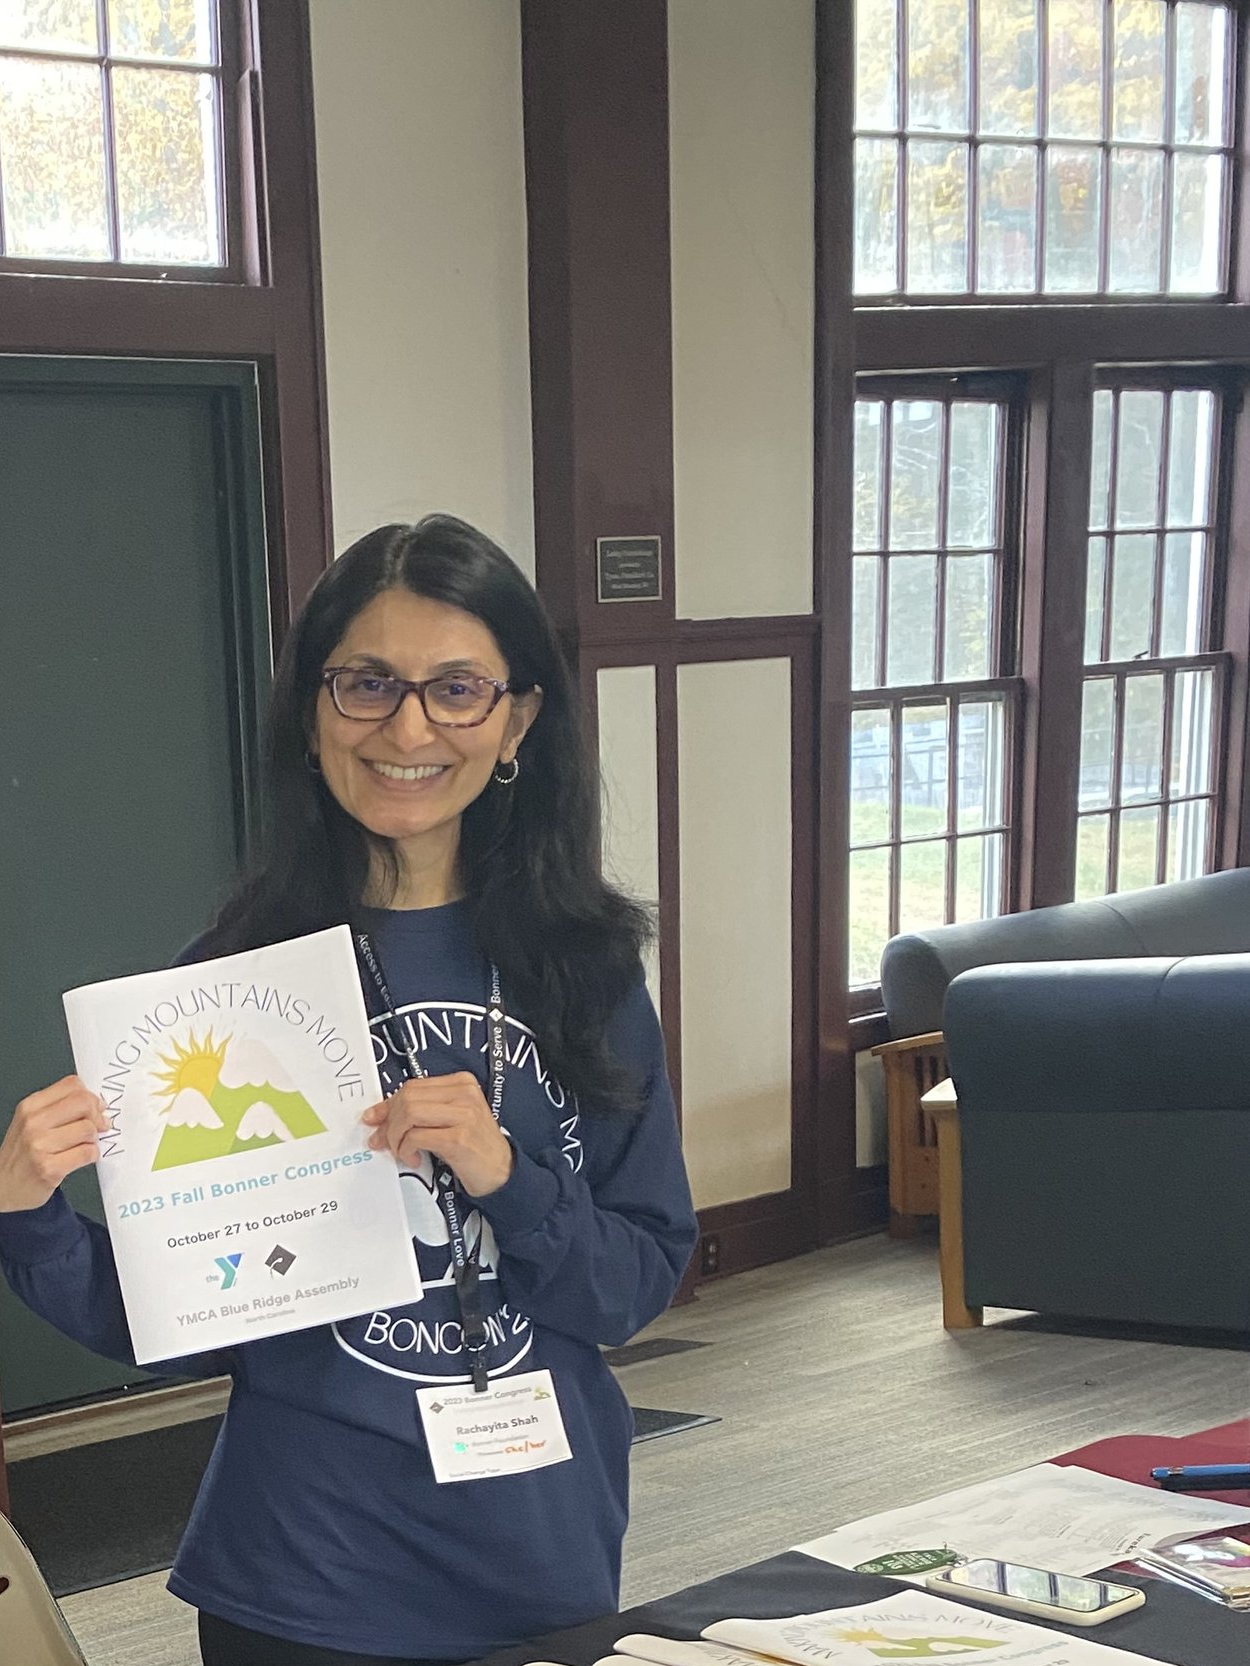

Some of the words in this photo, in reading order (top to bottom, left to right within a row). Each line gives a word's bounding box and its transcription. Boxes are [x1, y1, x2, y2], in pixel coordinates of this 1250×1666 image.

[493, 1027, 503, 1057] Serve
[99, 1039, 141, 1158] MAKING
[132, 983, 311, 1044] MOUNTAINS
[306, 1014, 365, 1102] MOVE
[492, 1065, 506, 1120] ortunity
[119, 1197, 165, 1219] 2023
[171, 1187, 205, 1207] Fall
[210, 1170, 279, 1197] Bonner
[285, 1149, 373, 1182] Congress
[167, 1229, 221, 1249] October
[225, 1223, 242, 1236] 27
[245, 1220, 259, 1231] to
[263, 1206, 317, 1228] October
[320, 1201, 338, 1214] 29
[445, 1192, 459, 1234] Bonner
[454, 1238, 465, 1267] Love
[176, 1309, 217, 1327] YMCA
[221, 1301, 250, 1318] Blue
[252, 1292, 291, 1312] Ridge
[295, 1276, 359, 1301] Assembly
[495, 1387, 532, 1399] Congress
[457, 1421, 509, 1435] Rachayita
[511, 1415, 538, 1426] Shah
